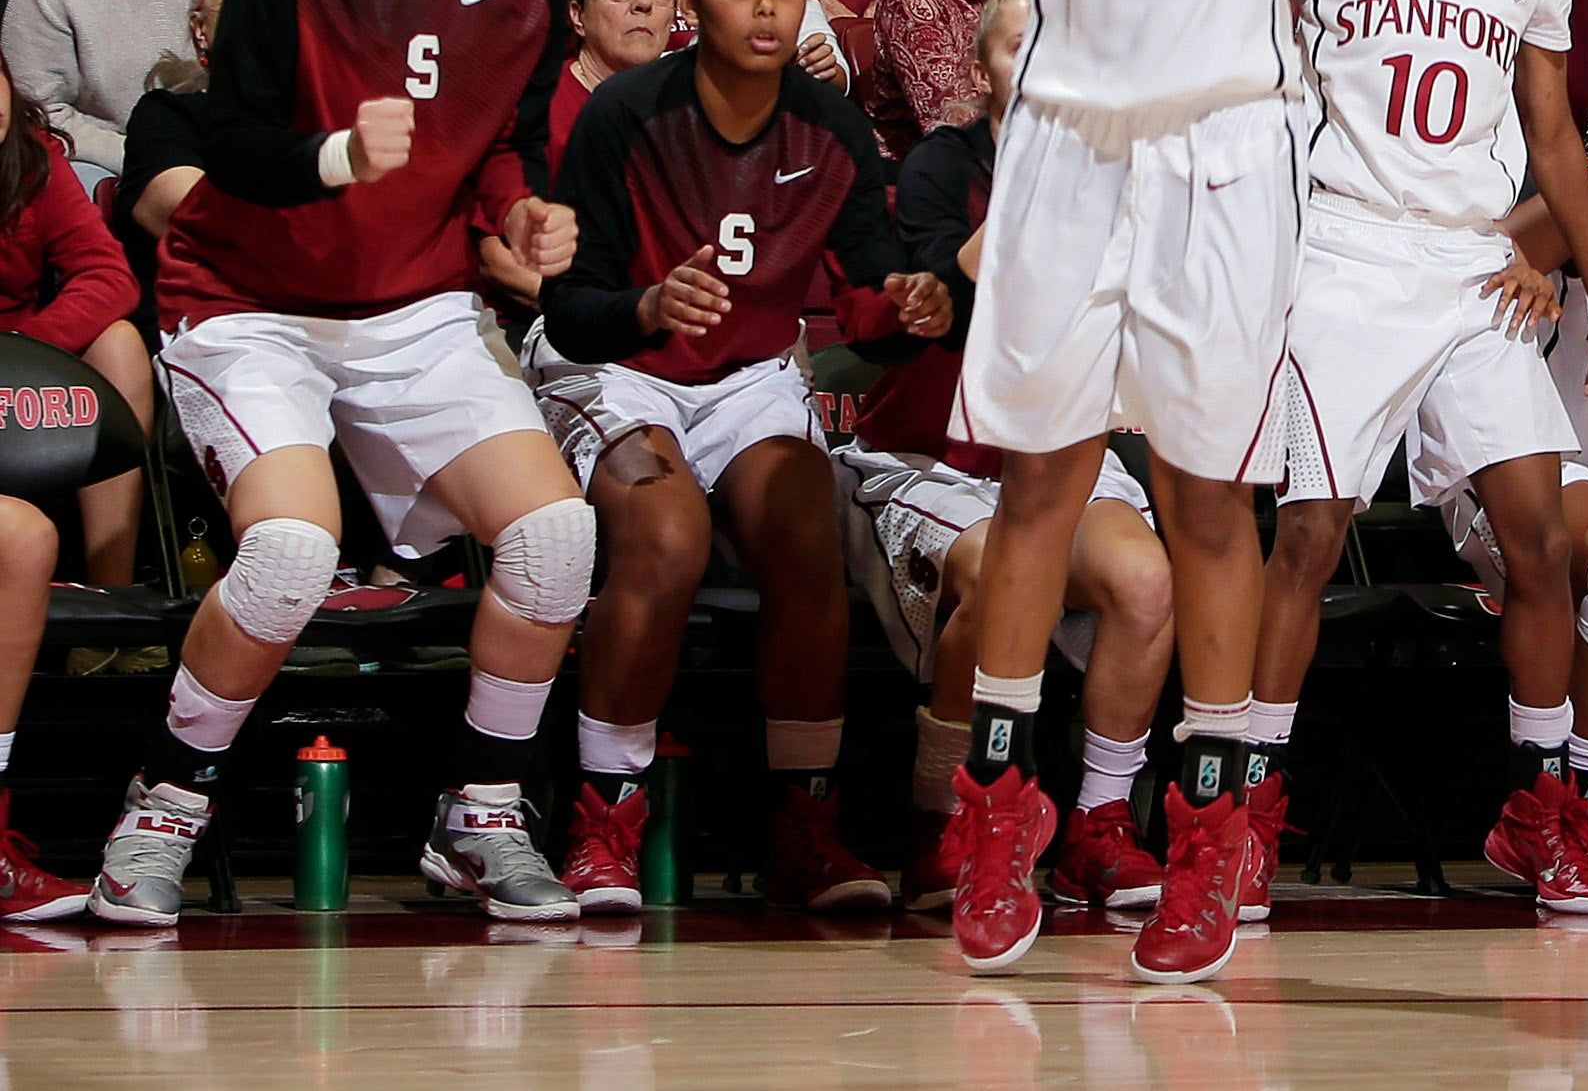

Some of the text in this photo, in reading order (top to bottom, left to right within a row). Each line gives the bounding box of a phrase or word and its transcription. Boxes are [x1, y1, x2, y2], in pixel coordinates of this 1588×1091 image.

[405, 34, 440, 99] S
[1381, 53, 1469, 145] 10
[717, 213, 755, 276] S
